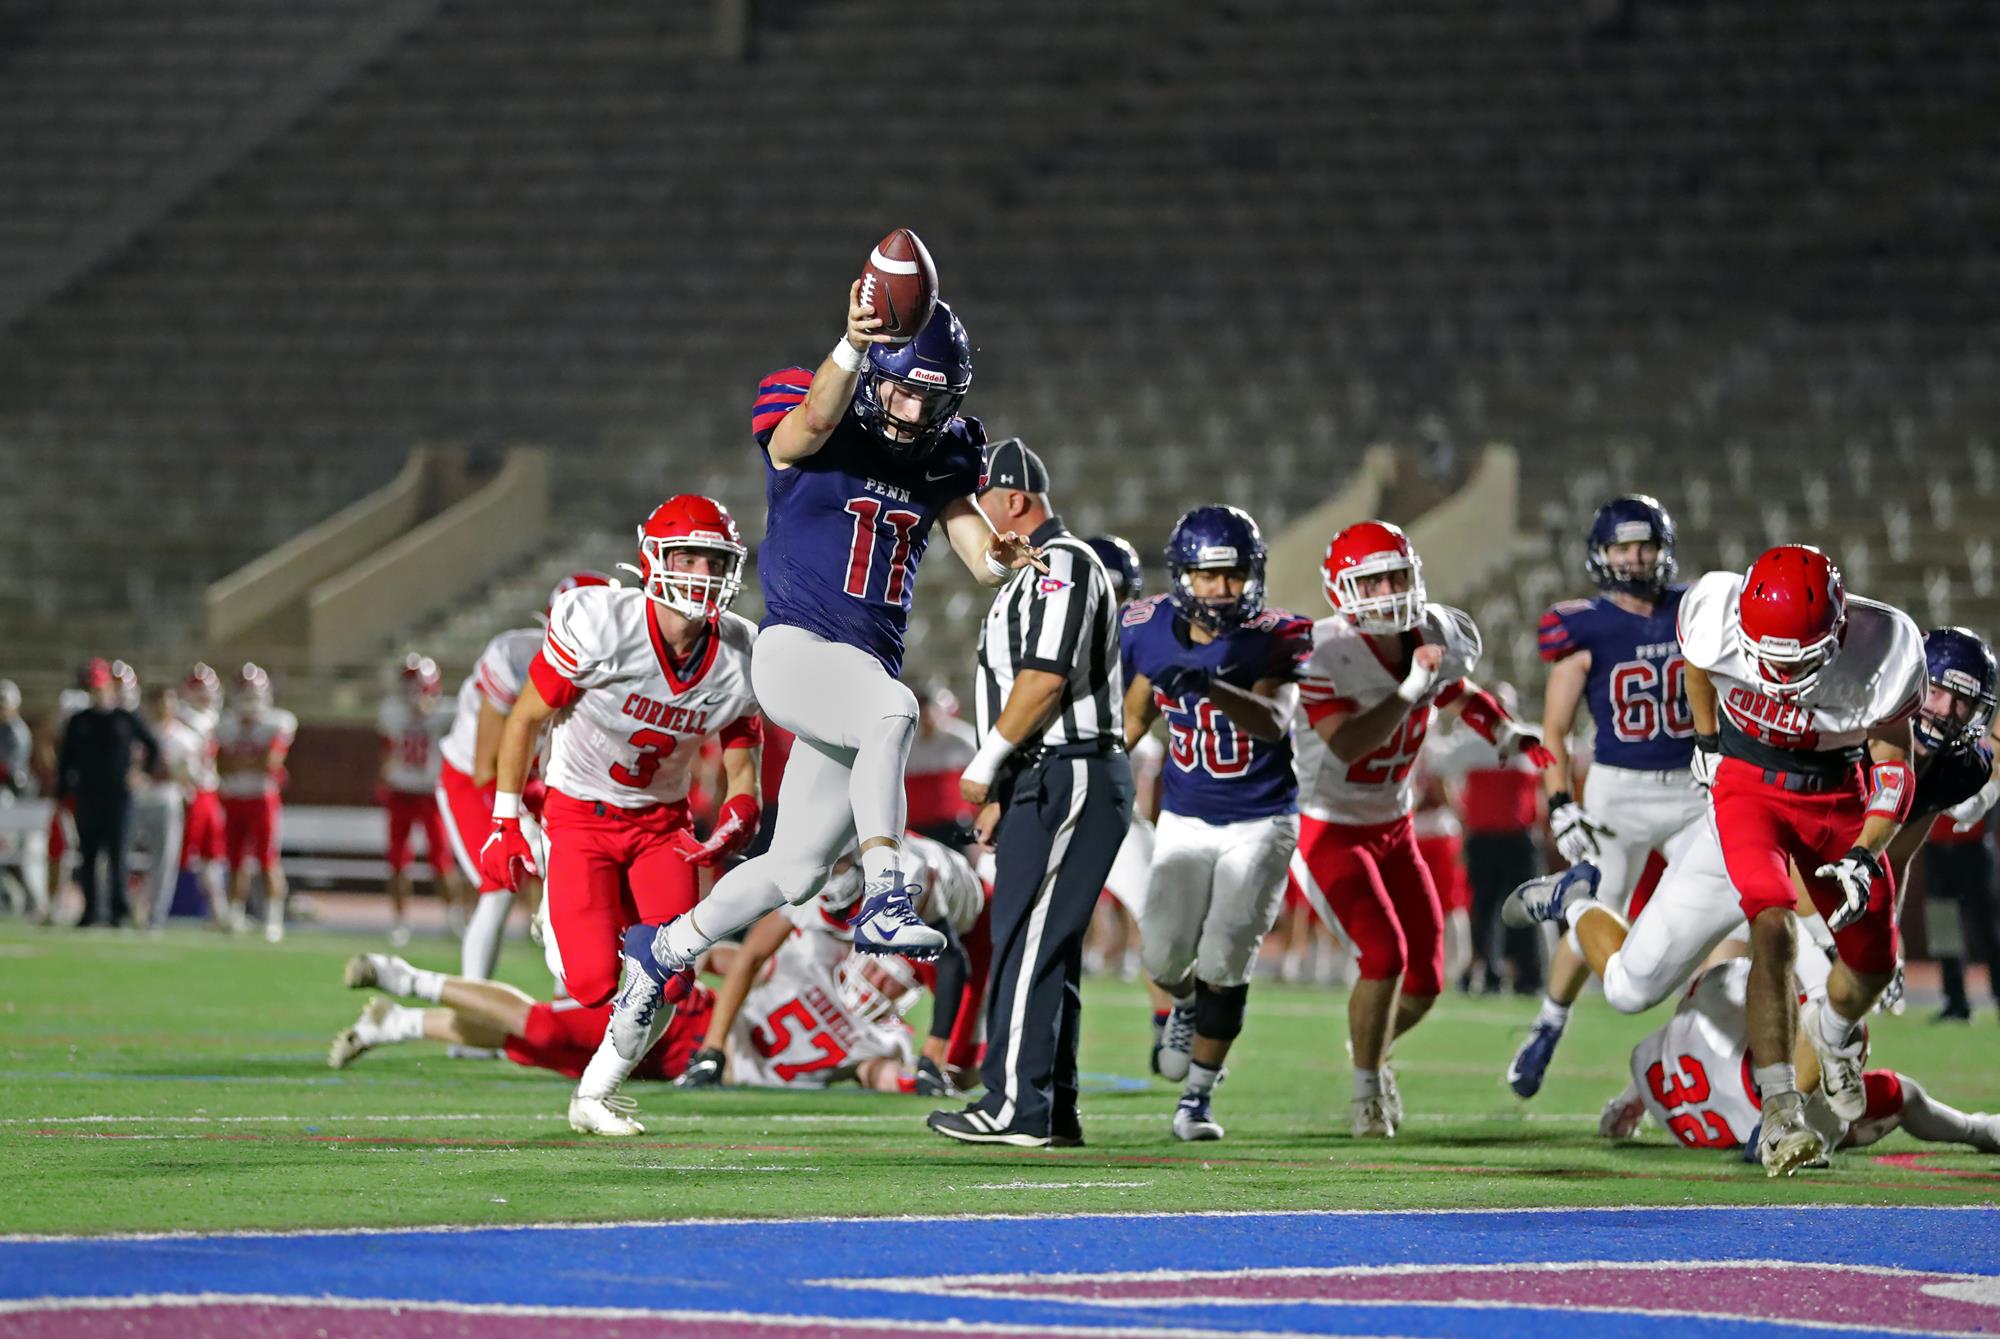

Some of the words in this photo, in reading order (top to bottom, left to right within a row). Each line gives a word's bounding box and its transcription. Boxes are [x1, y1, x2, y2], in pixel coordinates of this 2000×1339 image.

[915, 371, 945, 383] Riddell
[864, 477, 911, 503] PENN
[843, 497, 921, 606] 11
[1636, 640, 1679, 660] PENN
[622, 692, 708, 735] CORNELL
[1610, 652, 1696, 743] 60
[1728, 687, 1816, 734] CORNELL
[609, 728, 677, 789] 3
[1344, 705, 1430, 784] 29
[752, 998, 848, 1082] 57
[1645, 1054, 1738, 1149] 32
